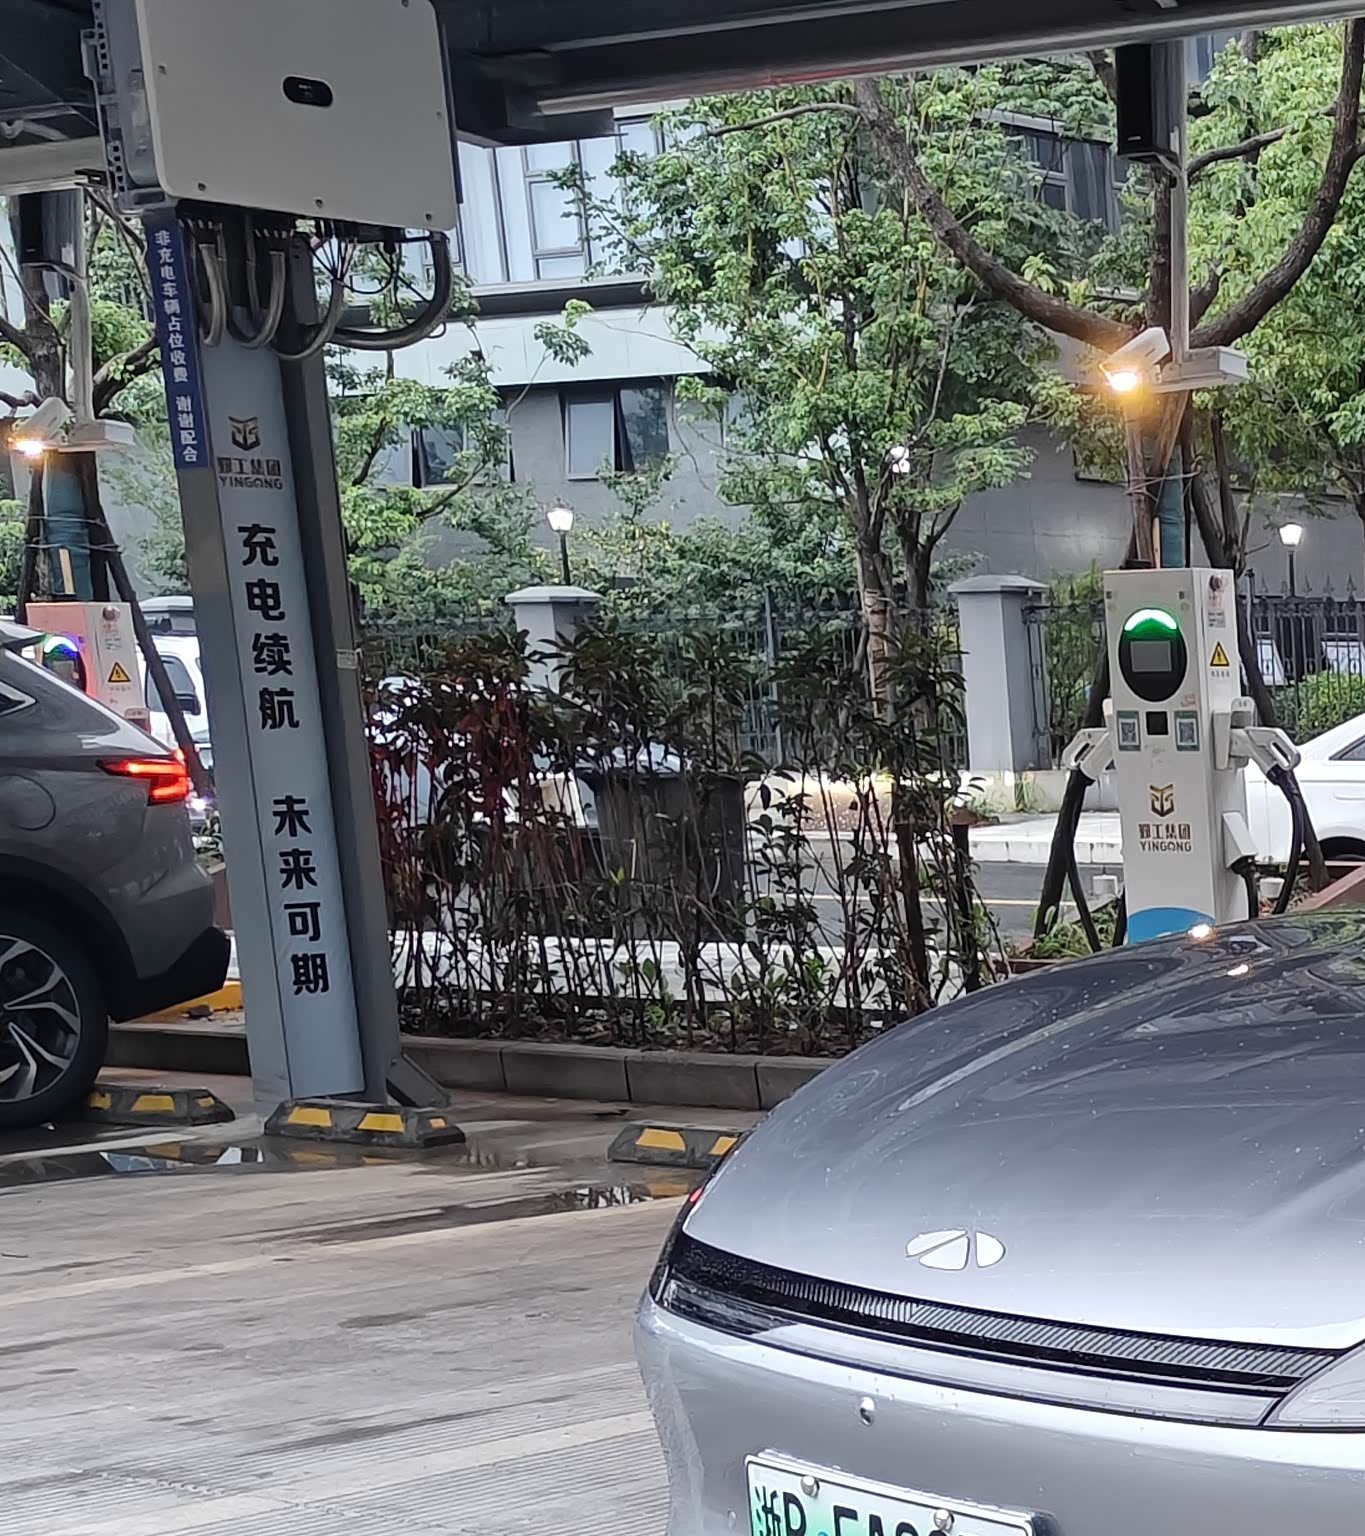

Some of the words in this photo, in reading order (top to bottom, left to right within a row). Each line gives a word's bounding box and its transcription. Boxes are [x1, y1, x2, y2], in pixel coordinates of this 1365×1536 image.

[155, 230, 188, 383] 非充电车辆占位收费
[219, 476, 283, 490] YINGONG
[237, 523, 300, 731] 充电续航
[272, 796, 330, 996] 未来可期
[1140, 841, 1191, 852] YINGONG
